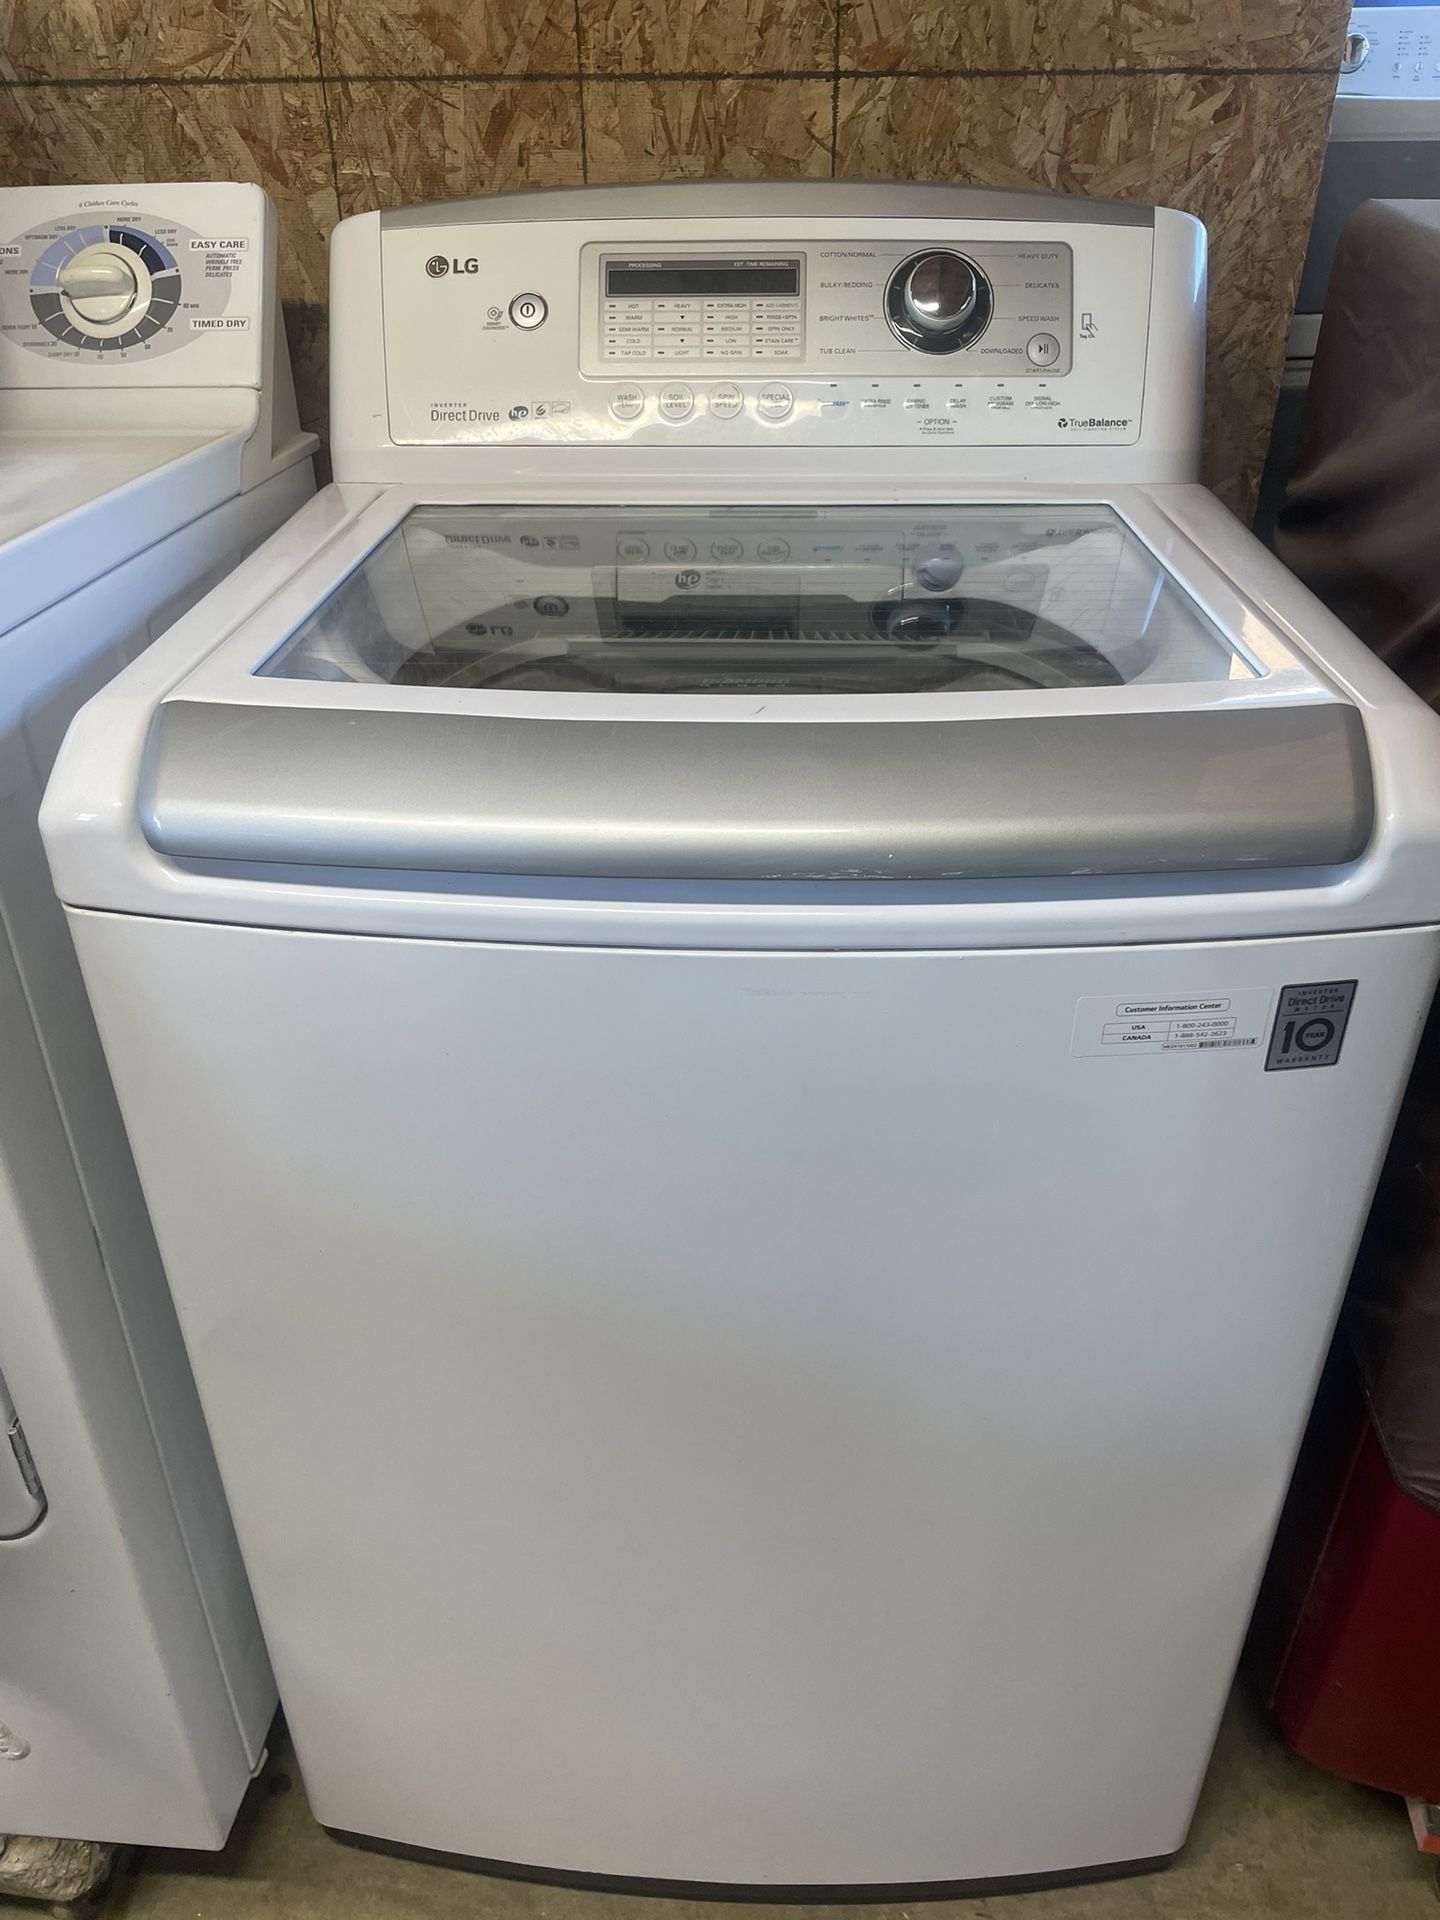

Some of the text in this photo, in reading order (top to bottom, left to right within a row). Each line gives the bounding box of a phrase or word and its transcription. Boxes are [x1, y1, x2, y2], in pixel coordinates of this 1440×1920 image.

[453, 258, 479, 274] LG
[192, 319, 247, 328] TIMED DRY
[431, 410, 467, 421] Direct
[469, 410, 500, 421] Drive
[1288, 995, 1345, 1007] Direct Drive
[1158, 1004, 1198, 1012] Information
[1199, 1002, 1222, 1010] Center
[1176, 1021, 1229, 1029] 1-800-243-0000
[1281, 1018, 1335, 1054] 10
[1305, 1031, 1326, 1039] YEAR
[1276, 1054, 1330, 1065] WARRANTY
